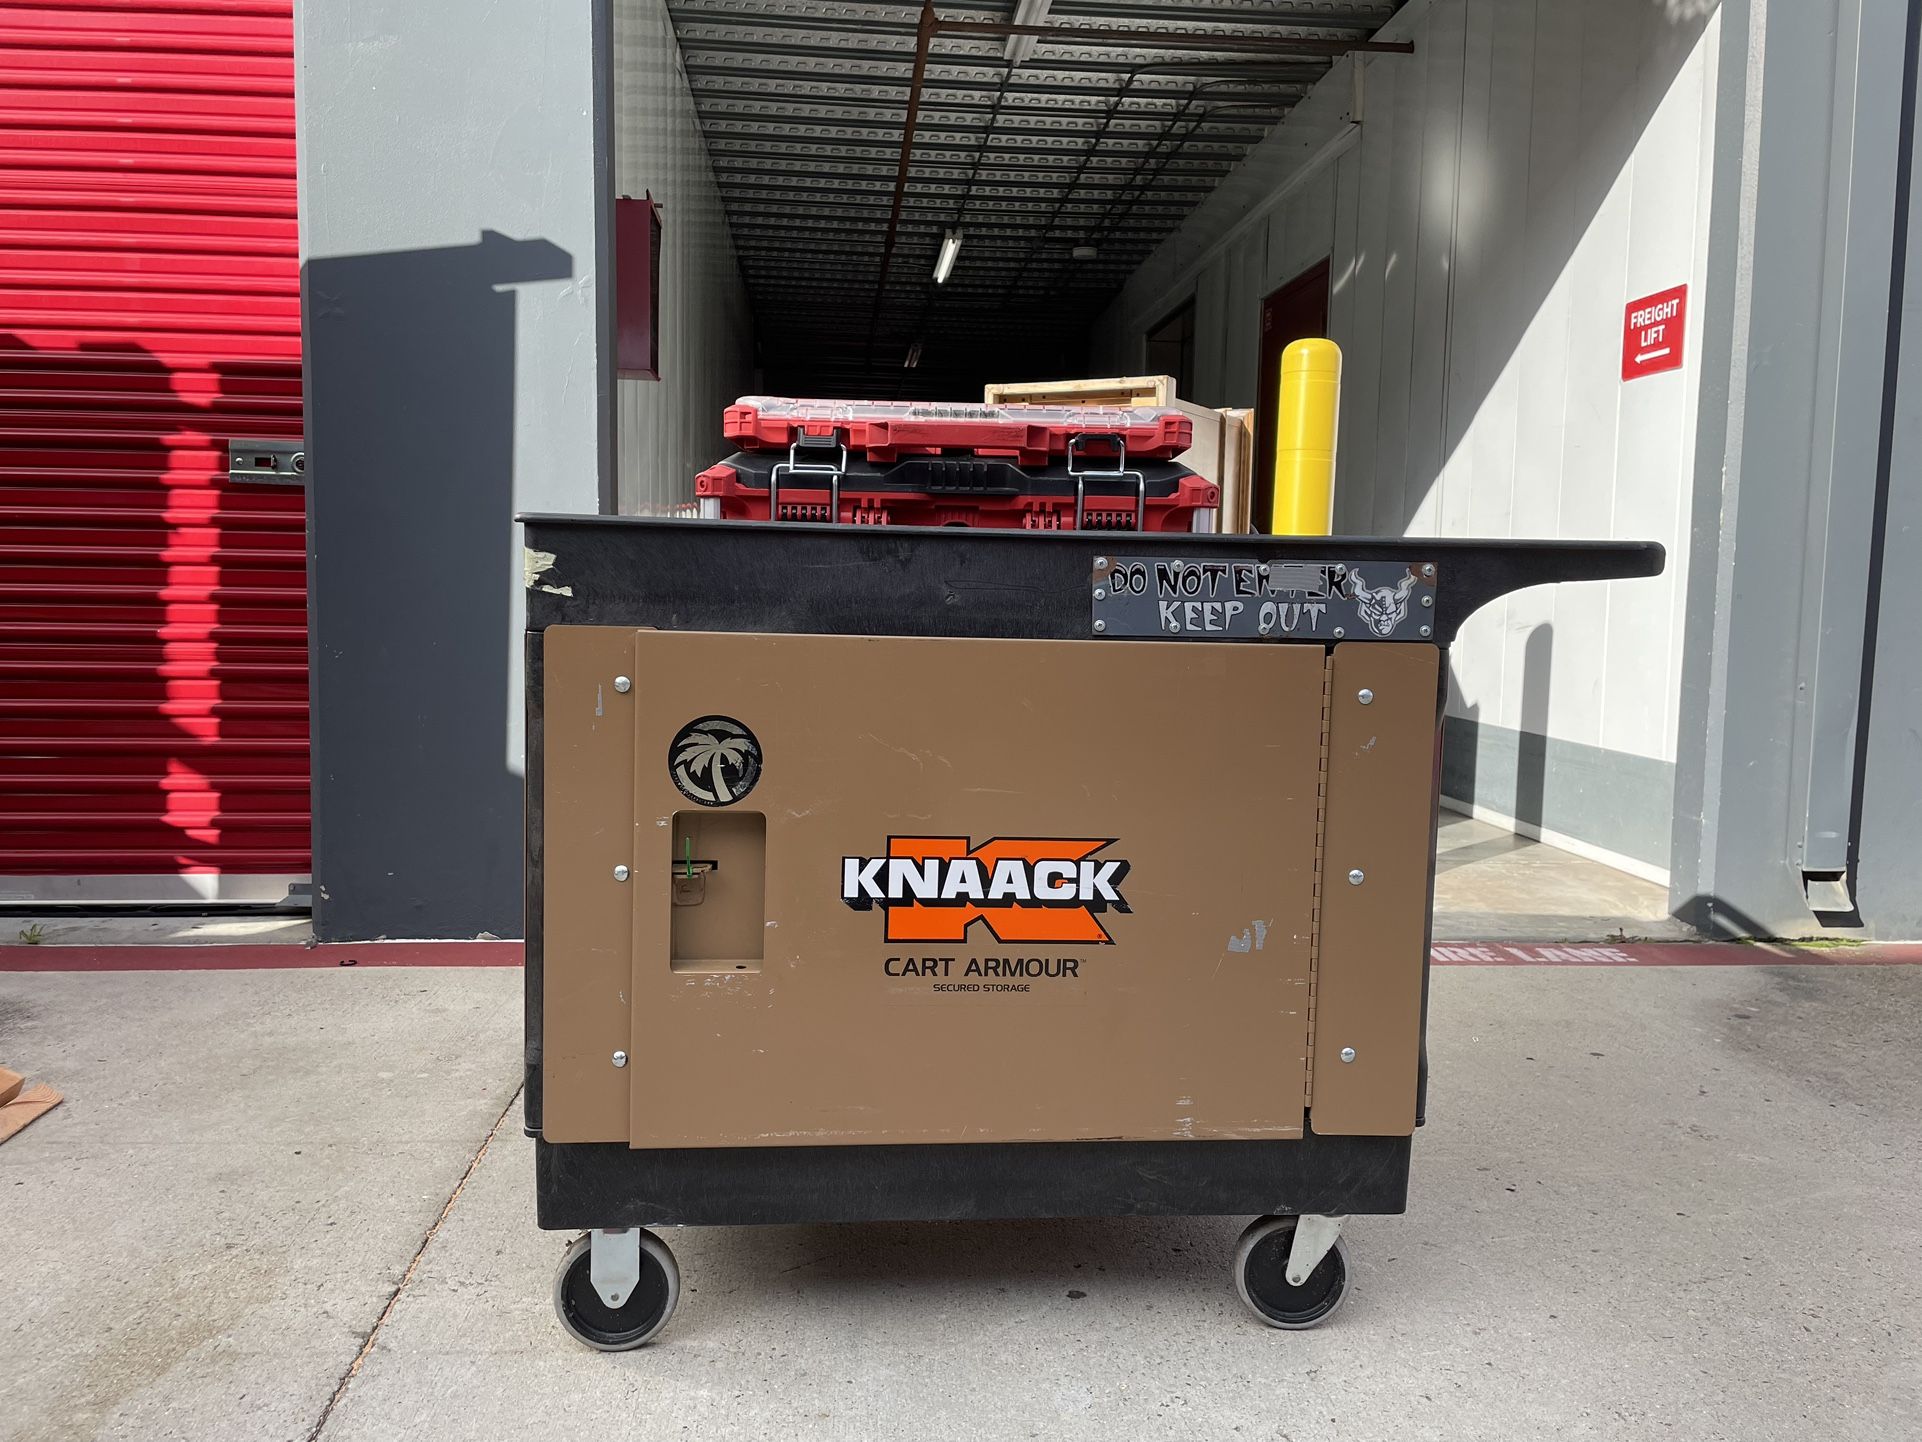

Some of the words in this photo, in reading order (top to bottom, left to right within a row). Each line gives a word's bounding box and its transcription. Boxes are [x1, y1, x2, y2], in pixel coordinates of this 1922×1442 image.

[1630, 298, 1680, 330] FREIGHT
[1640, 324, 1666, 347] LIFT
[1108, 562, 1148, 596] DO
[1155, 562, 1229, 599] NOT
[1158, 600, 1245, 632] KEEP
[1257, 600, 1328, 632] OUT
[842, 857, 1126, 904] KNAACK
[884, 957, 956, 977] CART
[1503, 946, 1640, 962] LANE
[933, 983, 980, 993] SECURED
[982, 984, 1031, 993] STORAGE
